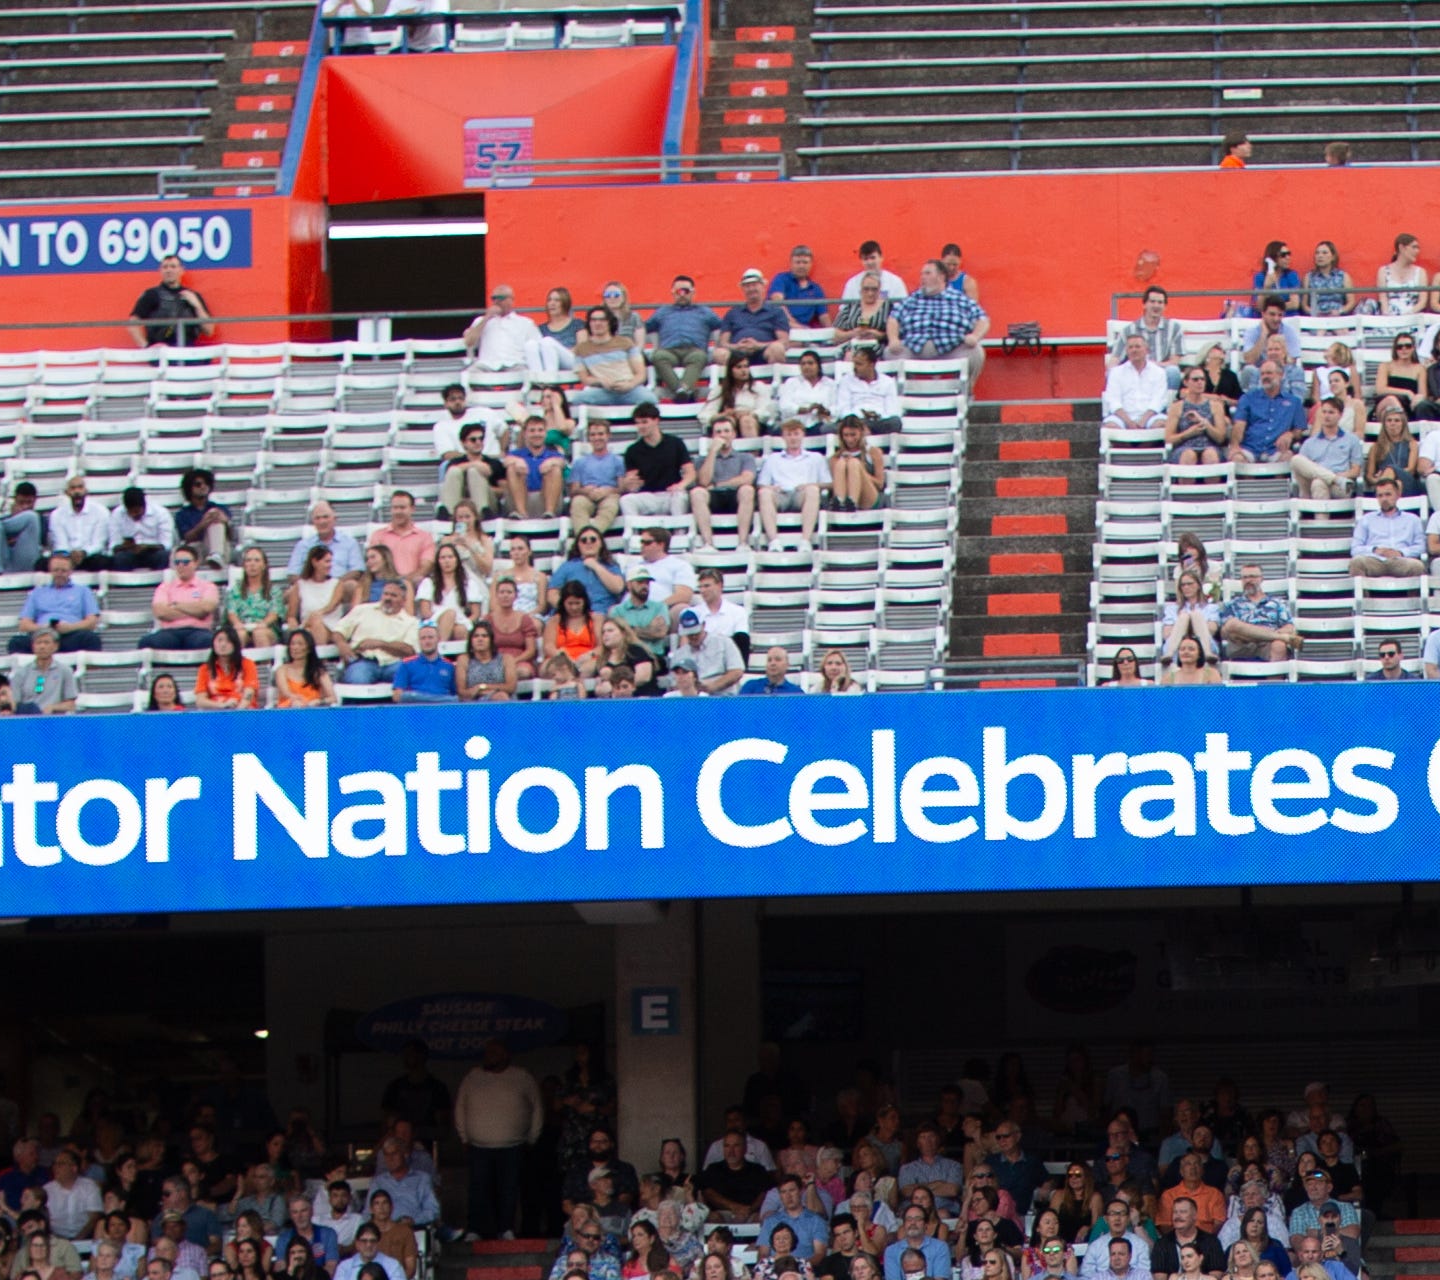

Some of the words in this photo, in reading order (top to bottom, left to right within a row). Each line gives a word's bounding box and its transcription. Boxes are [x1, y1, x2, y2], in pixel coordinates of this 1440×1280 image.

[476, 142, 522, 169] 57
[30, 220, 89, 266] TO
[98, 215, 232, 263] 69050
[233, 736, 664, 860] Nation
[697, 726, 1398, 848] Celebrates
[641, 995, 669, 1030] E
